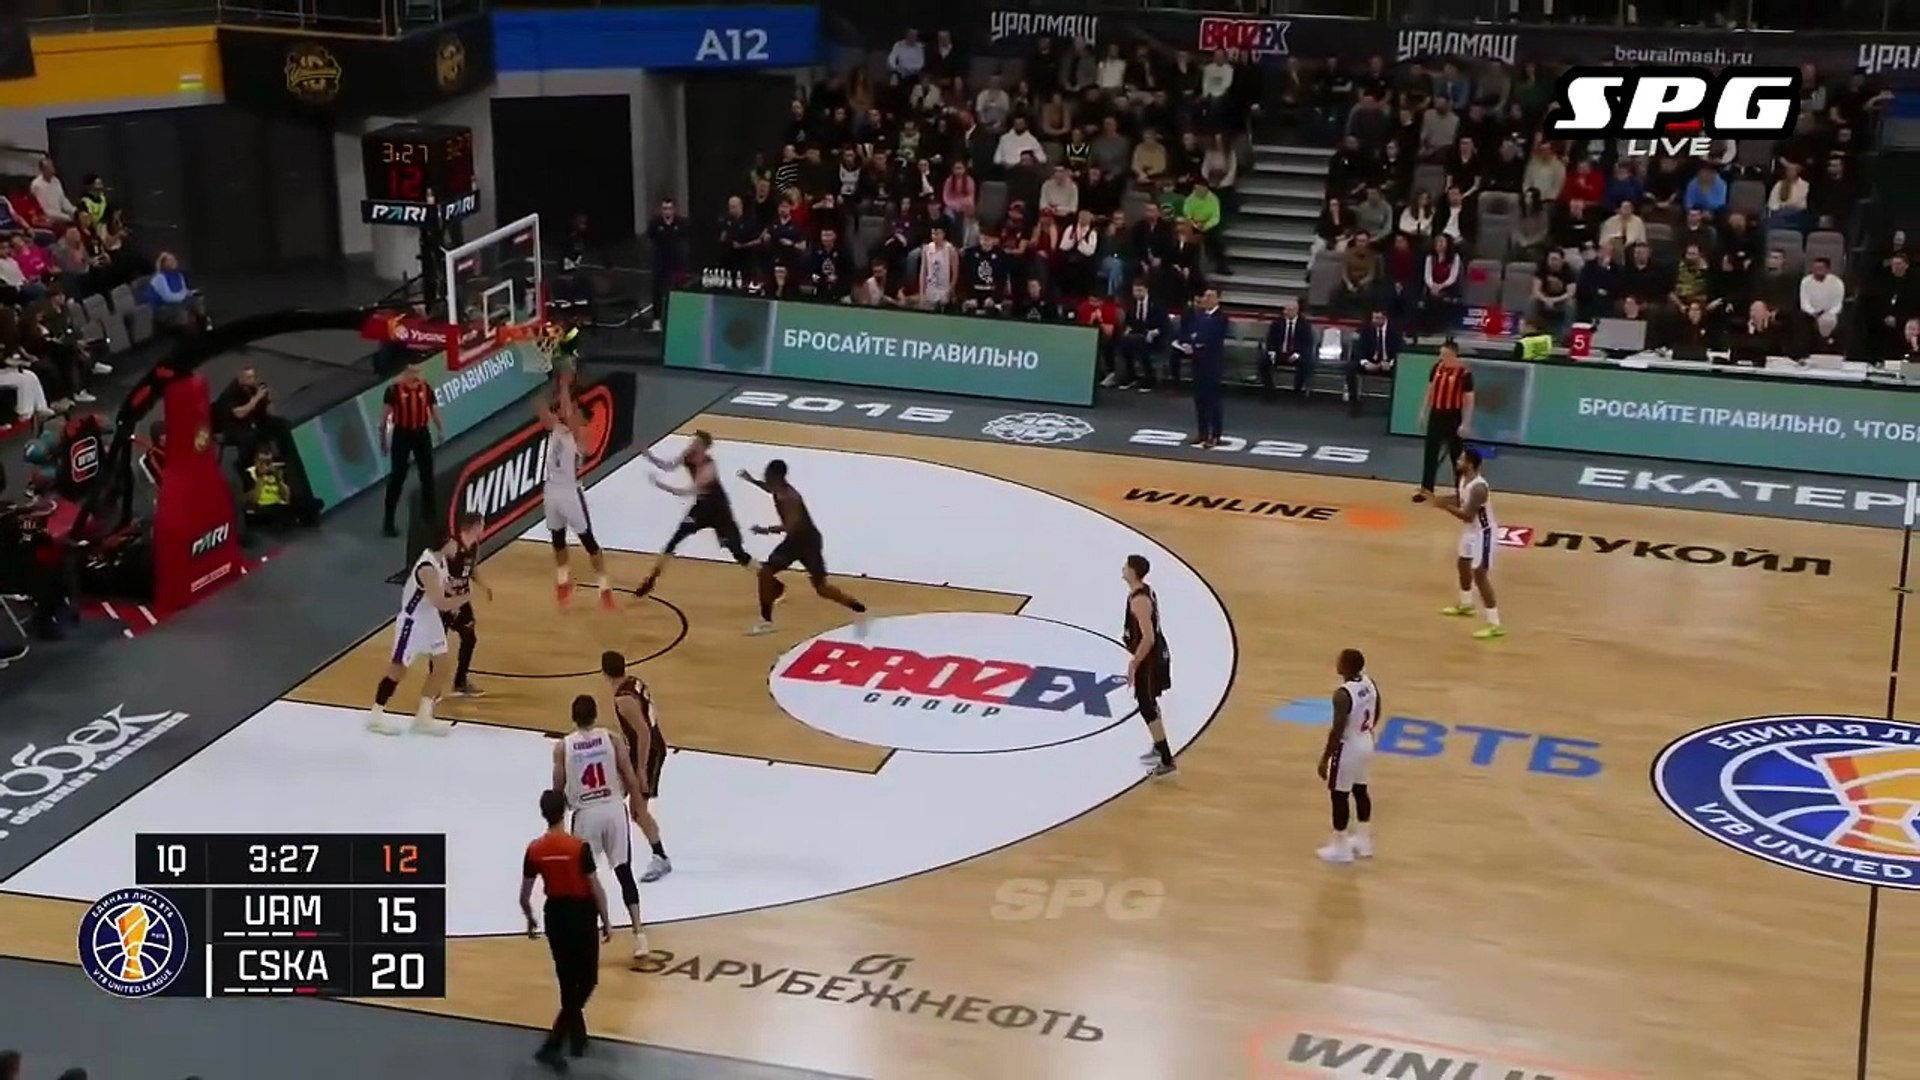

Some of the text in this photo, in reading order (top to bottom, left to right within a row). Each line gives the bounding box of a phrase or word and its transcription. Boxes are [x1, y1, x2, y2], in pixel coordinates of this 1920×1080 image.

[990, 11, 1098, 46] УРАЛМАШ
[1199, 17, 1291, 55] BROZEX
[1397, 30, 1518, 66] УРАЛМАШ
[1613, 45, 1754, 67] bcuralmash.ru
[382, 142, 429, 165] 3:27
[388, 166, 423, 199] 12
[371, 204, 428, 223] PARI
[783, 327, 1040, 371] БРОСАЙТЕ ПРАВИЛЬНО
[442, 349, 516, 404] ПРАВИЛЬНО
[729, 390, 954, 424] 2015
[1578, 396, 1697, 425] БРОСАЙТЕ
[1699, 407, 1847, 440] ПРАВИЛЬНО,
[464, 434, 552, 517] WINLI
[1124, 486, 1340, 522] WINLINE
[1534, 530, 1832, 577] ЛУКОЙЛ
[780, 638, 1121, 719] BROZEX
[862, 691, 1001, 718] GROUP
[1376, 716, 1606, 779] ВТБ
[1708, 723, 1920, 751] ЕДИНАЯ Л
[581, 762, 607, 790] 41
[1694, 801, 1914, 880] VTB UNITED
[629, 949, 1105, 1044] ЗАРУБЕЖНЕФТЬ
[1286, 1032, 1557, 1080] WINL
